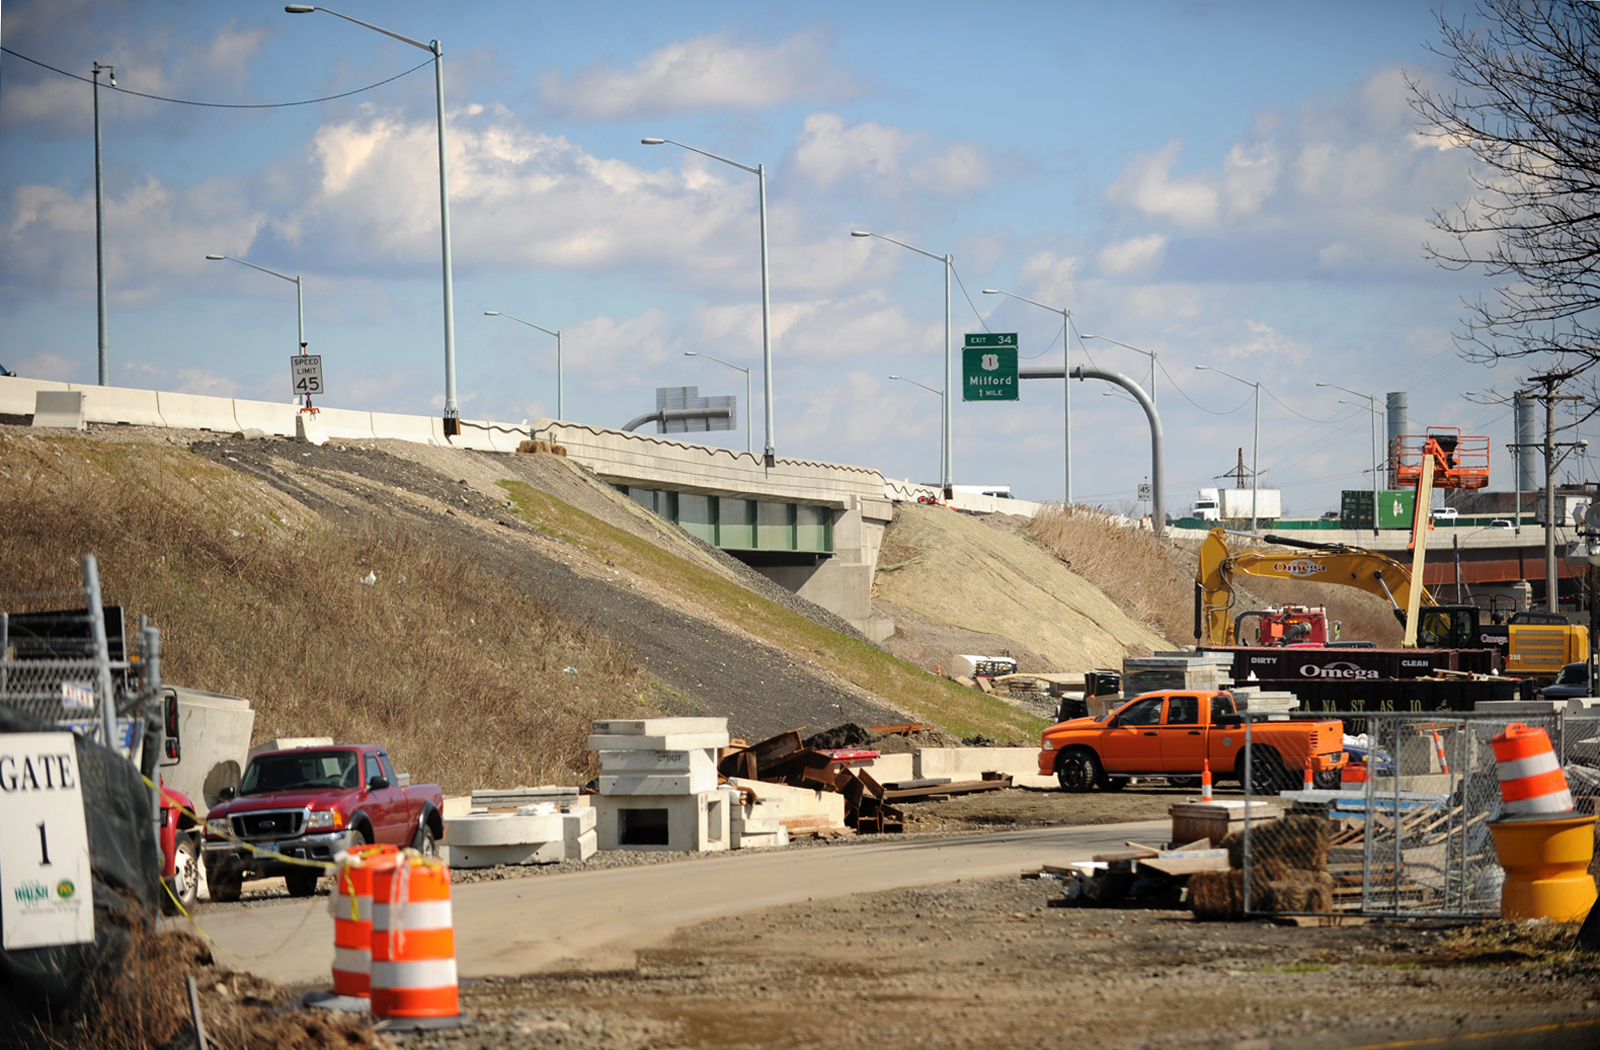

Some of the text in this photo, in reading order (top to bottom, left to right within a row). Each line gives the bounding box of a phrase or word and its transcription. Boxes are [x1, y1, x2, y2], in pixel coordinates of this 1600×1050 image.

[997, 335, 1012, 344] 34
[294, 358, 319, 366] SPEED
[297, 367, 317, 375] LIMIT
[296, 376, 320, 391] 45
[969, 376, 1012, 385] Milford
[1139, 486, 1151, 494] 45
[1273, 559, 1327, 577] Omega
[1480, 633, 1509, 645] Omega
[1299, 661, 1380, 680] Omega
[656, 754, 682, 762] CTDOT
[0, 753, 76, 792] GATE
[35, 818, 53, 868] 1
